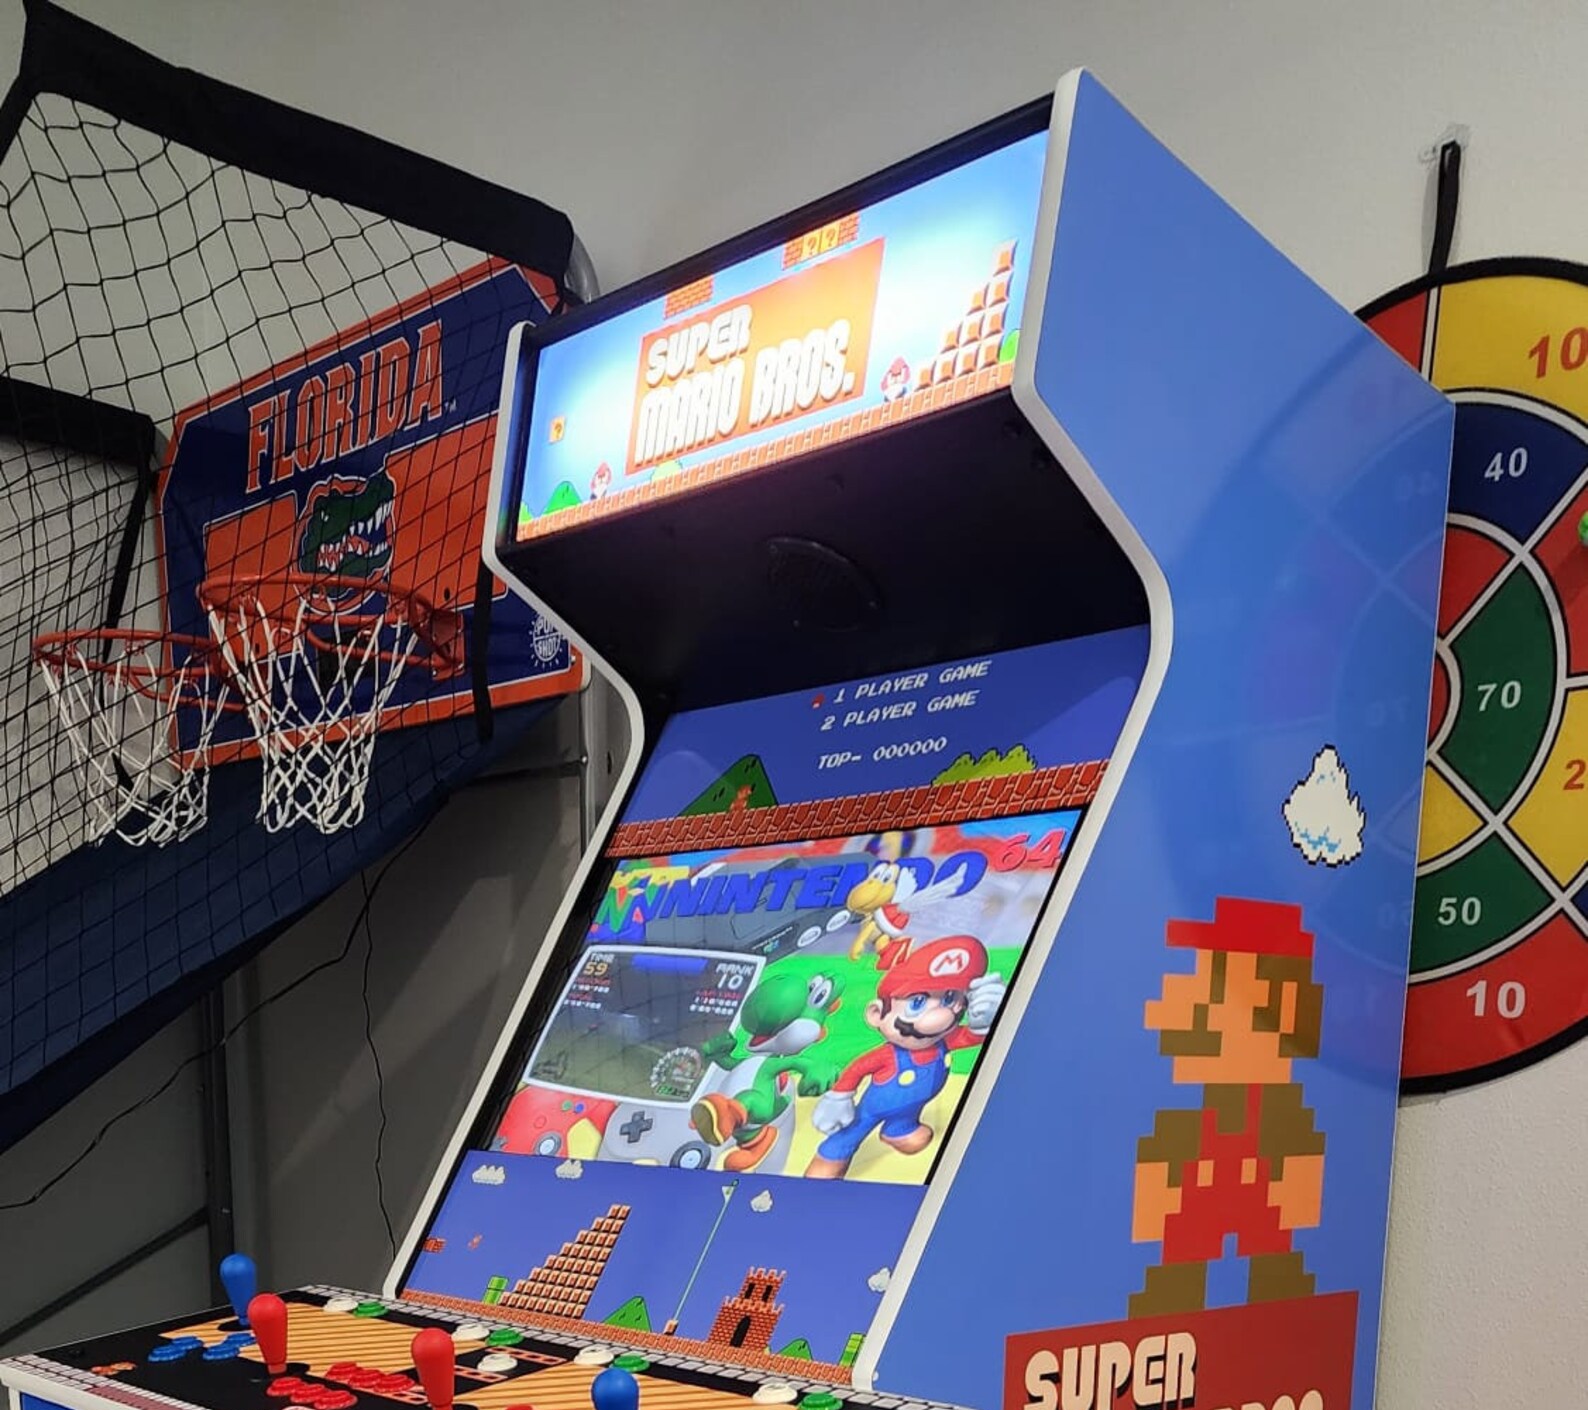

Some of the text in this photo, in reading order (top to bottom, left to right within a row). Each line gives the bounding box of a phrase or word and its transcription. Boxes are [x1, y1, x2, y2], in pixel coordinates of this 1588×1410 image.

[645, 304, 753, 388] SUPER
[1528, 326, 1588, 379] 10
[246, 318, 442, 494] FLORIDA
[634, 319, 856, 467] MARIO BROS.
[1484, 447, 1528, 482] 40
[833, 660, 992, 704] 1 PLAYER GAME
[1477, 680, 1522, 712] 70
[820, 690, 980, 731] 2 PLAYER GAME
[873, 736, 948, 762] 000000
[993, 829, 1066, 873] 64
[1437, 896, 1482, 926] 50
[583, 962, 608, 976] 59
[717, 973, 744, 990] 10
[1466, 979, 1527, 1019] 10
